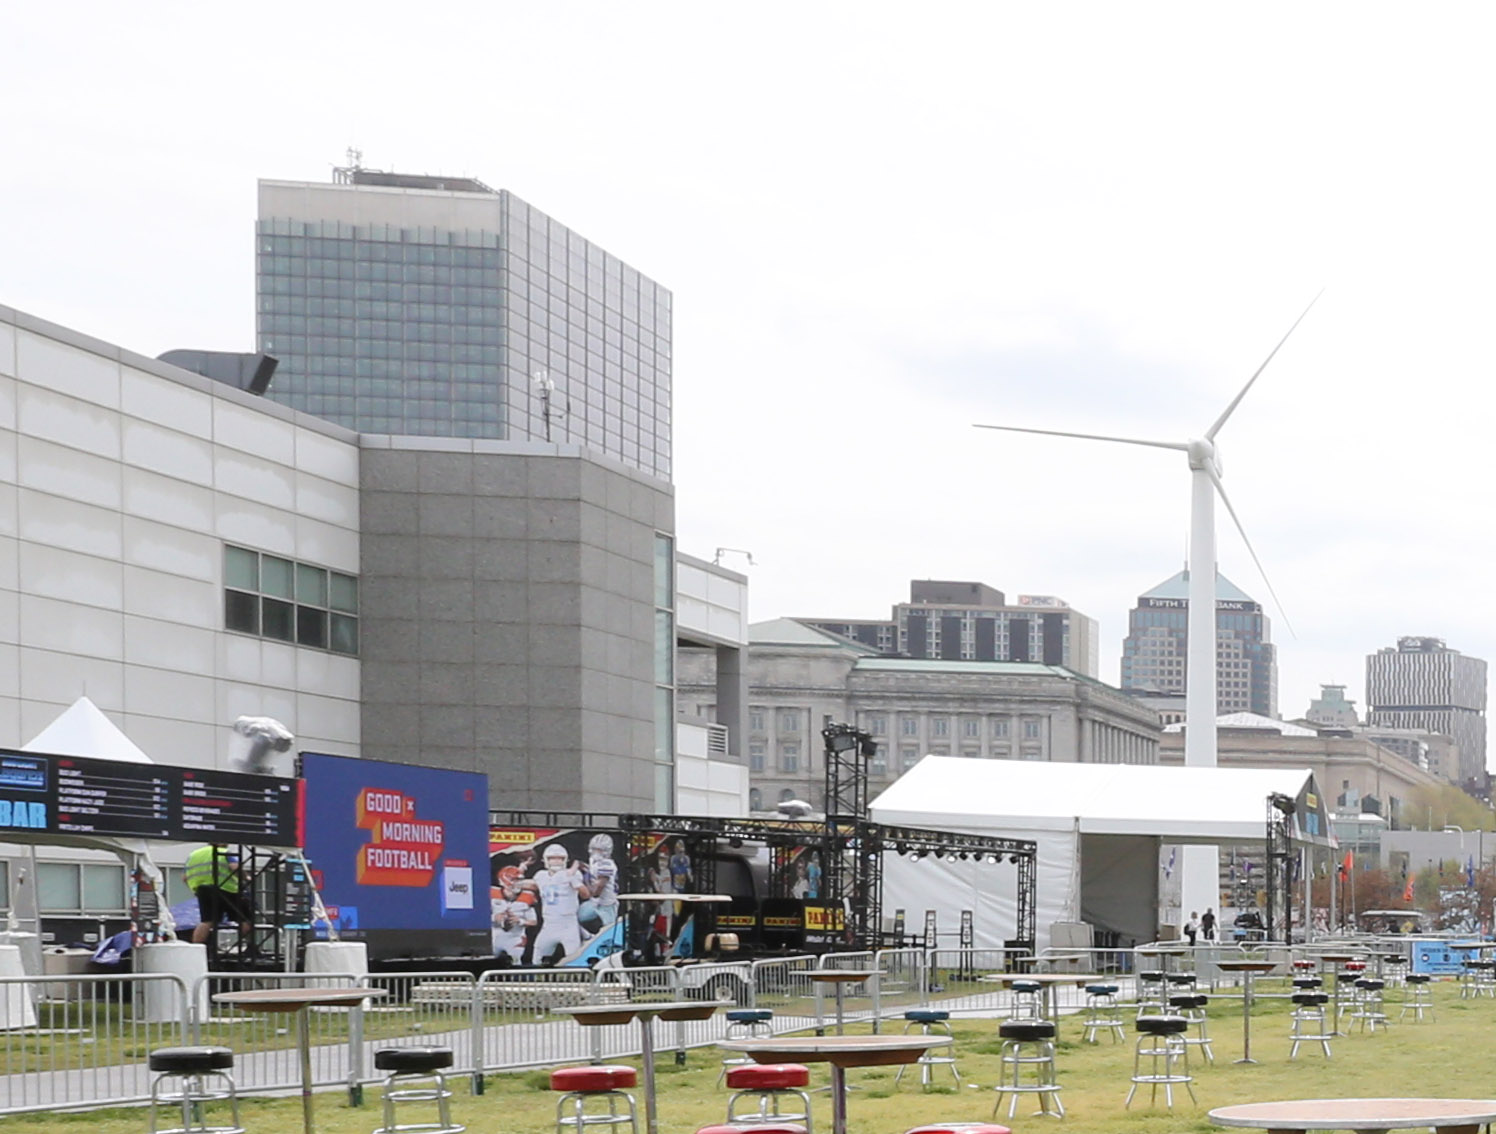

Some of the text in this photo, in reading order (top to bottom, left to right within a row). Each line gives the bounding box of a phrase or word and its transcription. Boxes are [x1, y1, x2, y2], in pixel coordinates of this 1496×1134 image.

[1149, 599, 1179, 608] FIFTH
[0, 799, 47, 828] BAR
[366, 792, 401, 814] GOOD
[382, 822, 443, 844] MORNING
[489, 832, 531, 842] PANINI
[367, 848, 433, 870] FOOTBALL
[449, 881, 469, 894] Jeep
